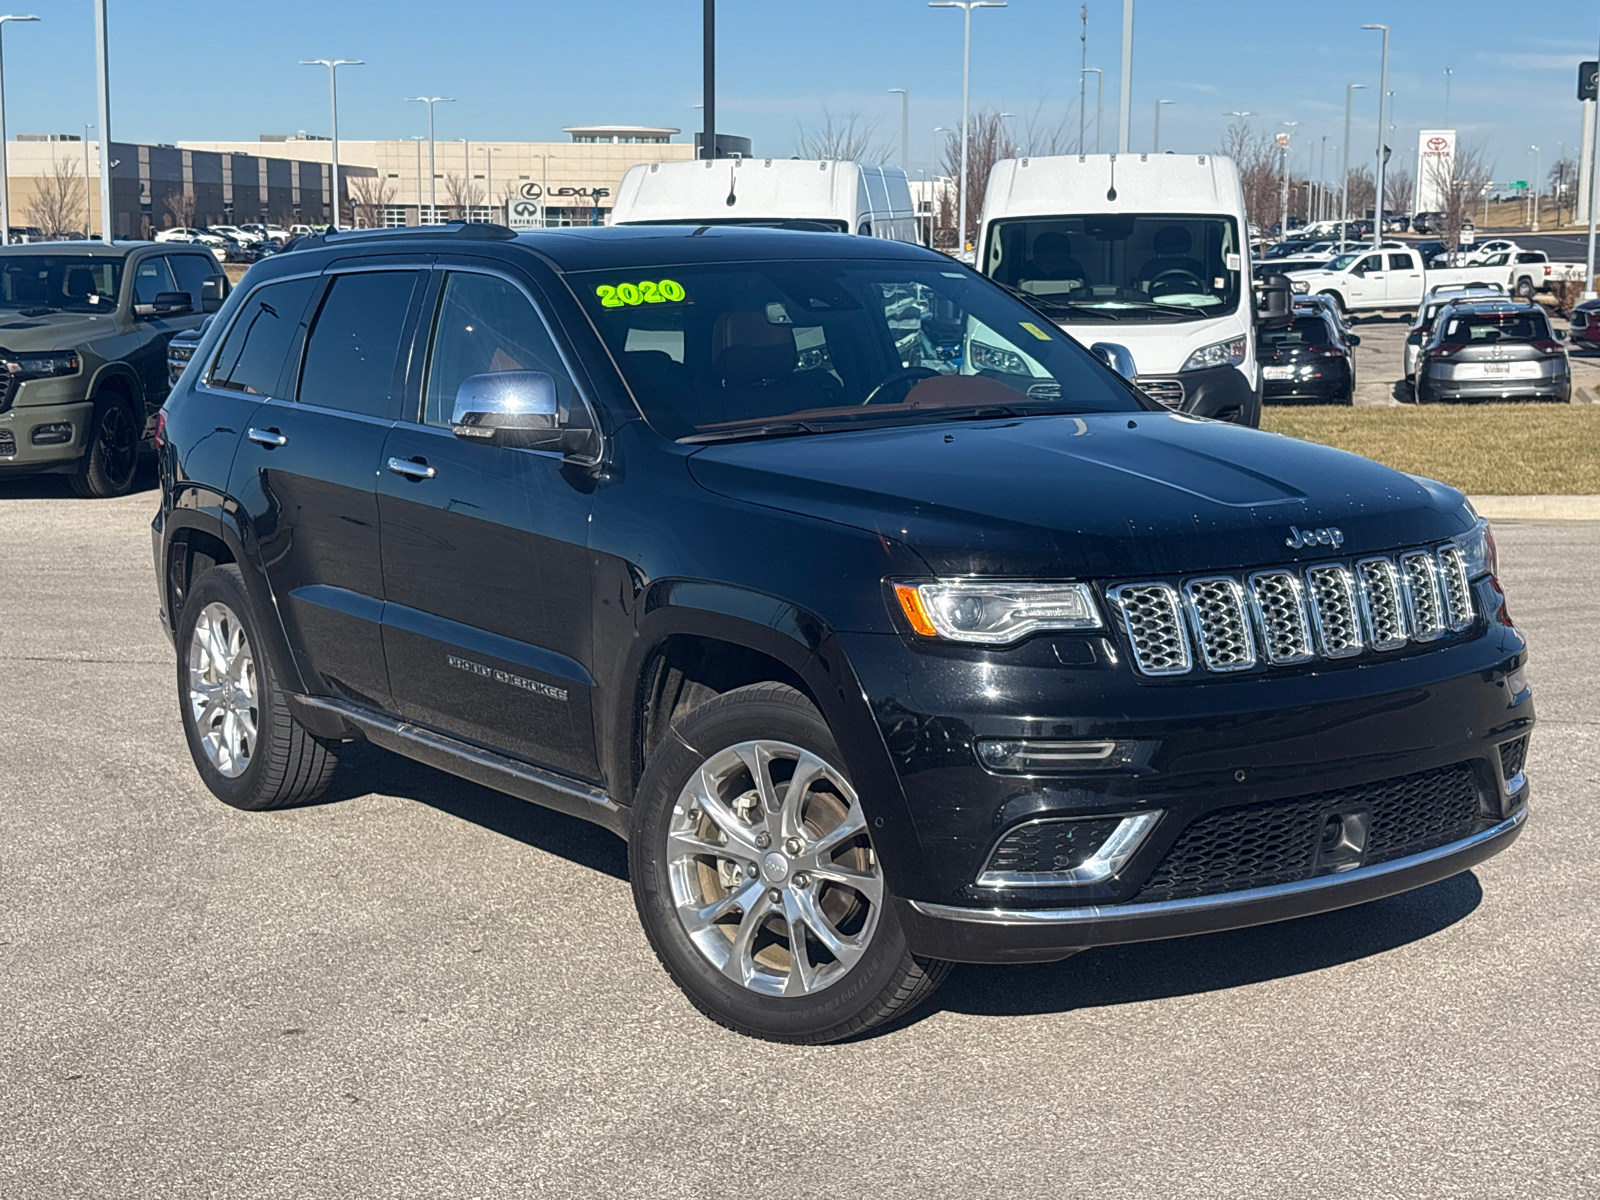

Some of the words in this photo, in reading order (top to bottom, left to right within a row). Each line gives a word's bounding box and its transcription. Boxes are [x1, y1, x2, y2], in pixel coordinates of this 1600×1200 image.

[547, 187, 610, 197] LEXUS
[596, 280, 686, 308] 2020
[1285, 525, 1345, 550] Jeep
[493, 669, 569, 701] CHEROKEE
